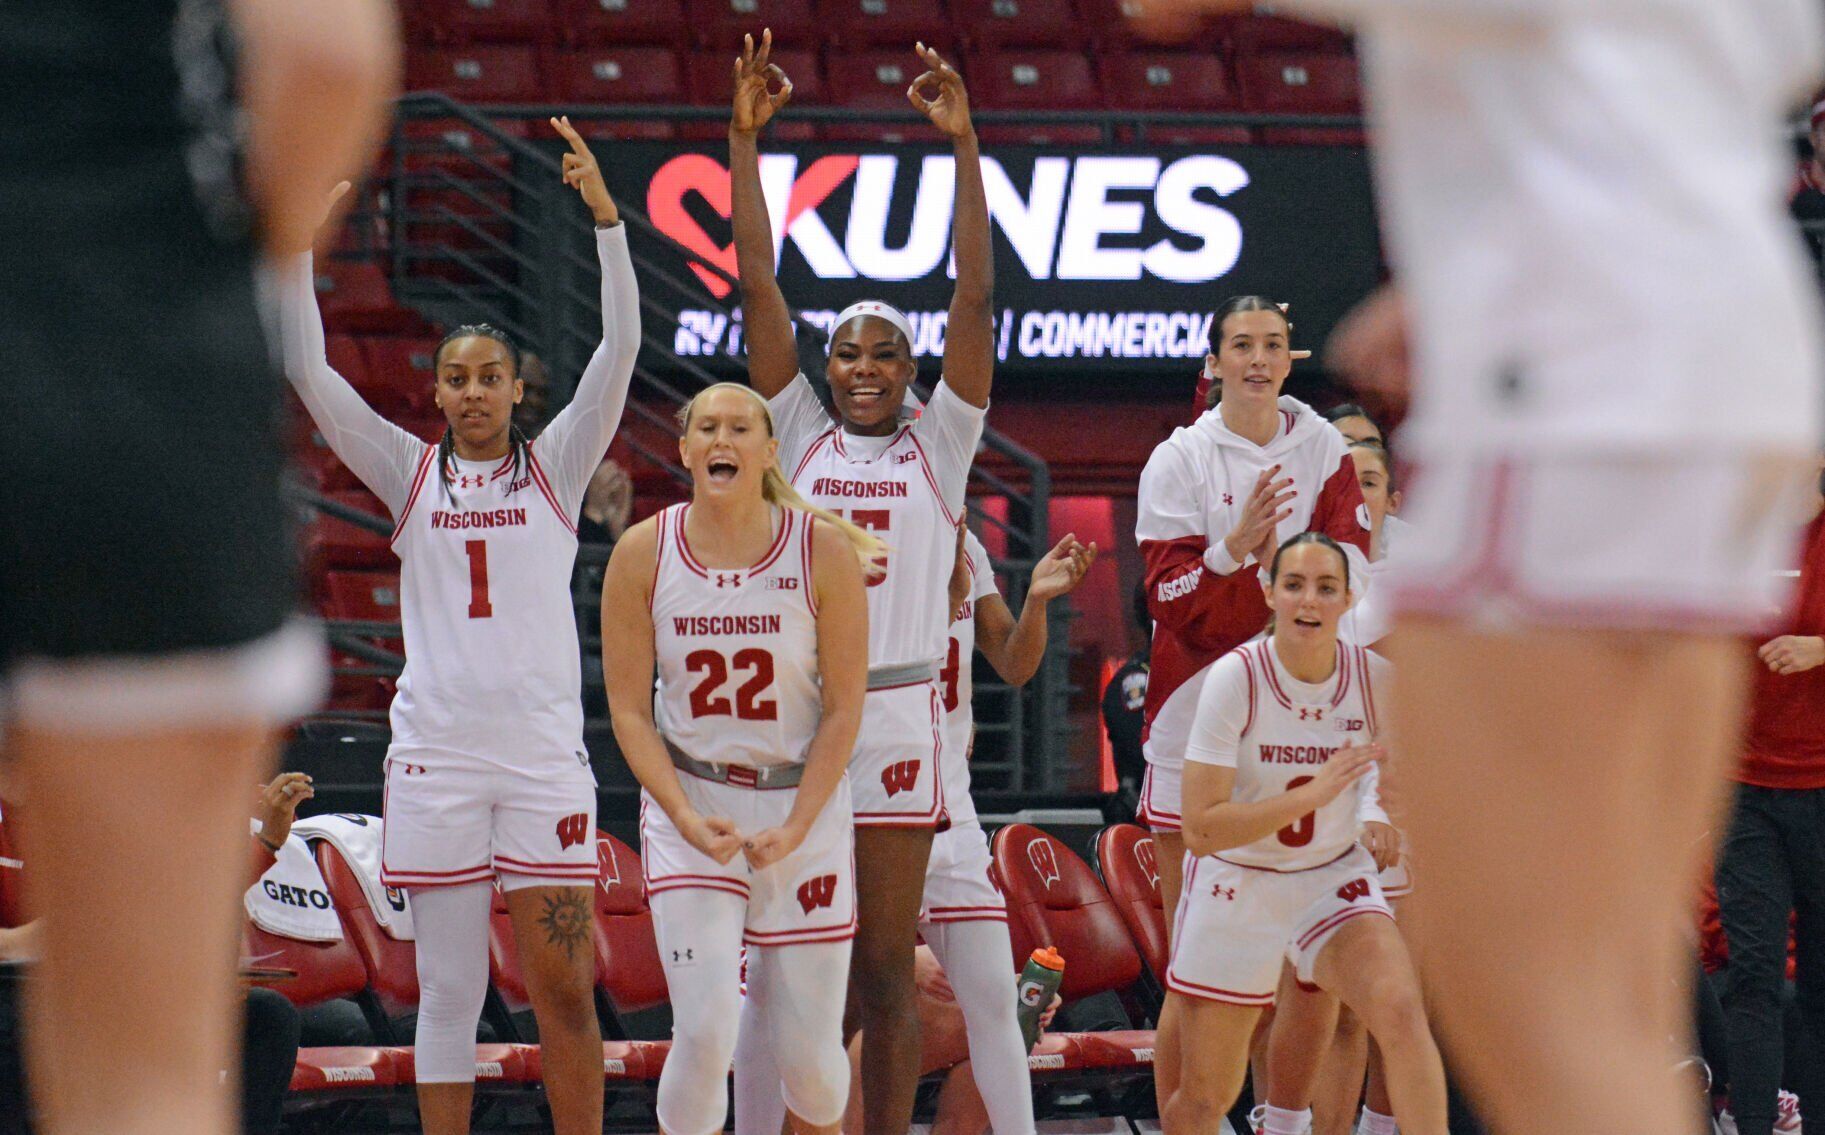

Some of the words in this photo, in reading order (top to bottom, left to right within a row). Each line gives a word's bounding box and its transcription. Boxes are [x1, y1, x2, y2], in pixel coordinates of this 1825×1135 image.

[757, 153, 1250, 282] KUNES
[811, 477, 908, 499] WISCONSIN
[431, 508, 527, 530] WISCONSIN
[465, 540, 493, 619] 1
[673, 614, 781, 637] WISCONSIN
[685, 647, 778, 721] 22
[263, 879, 334, 910] GATO
